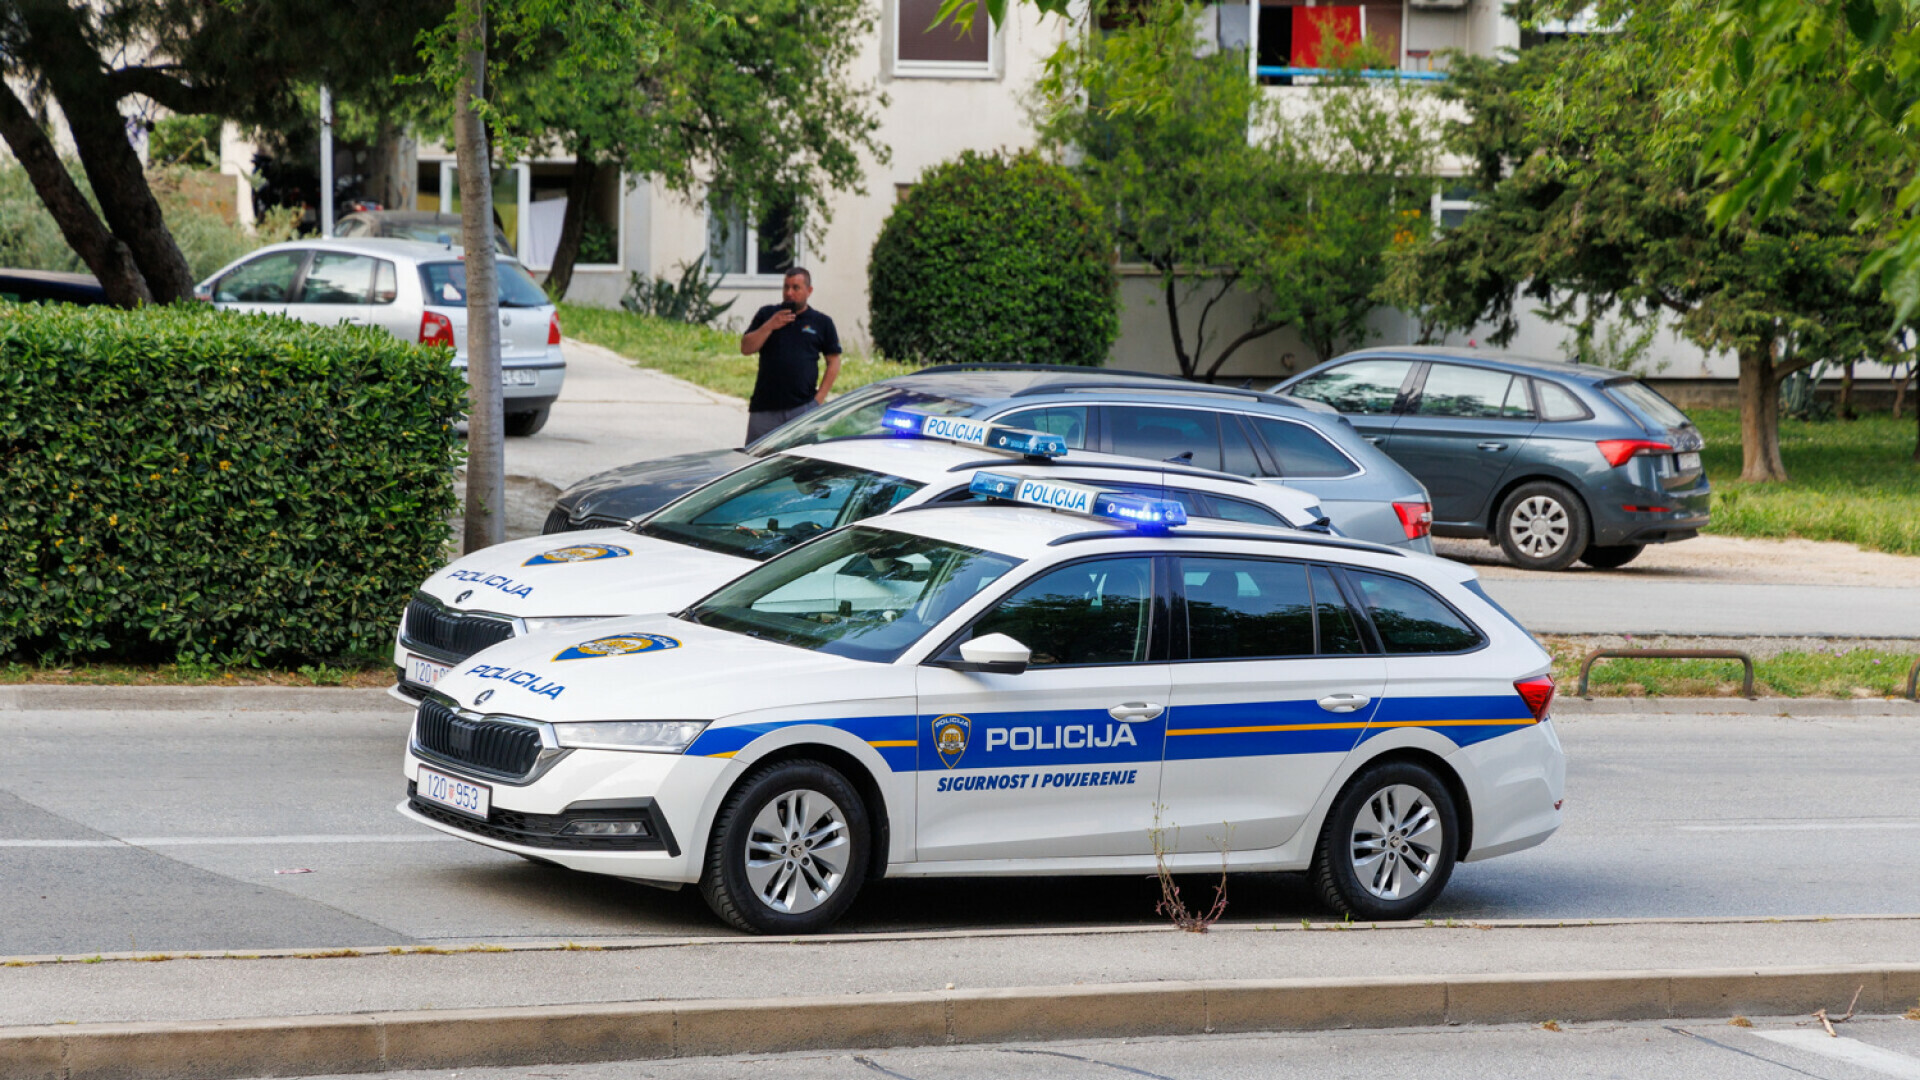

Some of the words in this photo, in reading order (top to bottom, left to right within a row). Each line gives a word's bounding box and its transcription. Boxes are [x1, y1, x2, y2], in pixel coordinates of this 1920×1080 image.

[927, 418, 984, 443] POLICIJA
[1021, 482, 1087, 510] POLICIJA
[447, 569, 534, 599] POLICIJA
[415, 661, 431, 682] 120
[465, 664, 566, 700] POLICIJA
[986, 724, 1138, 752] POLICIJA
[428, 774, 447, 800] 120
[455, 782, 478, 810] 953
[936, 774, 1030, 792] SIGURNOST
[1031, 774, 1039, 789] I
[1041, 769, 1138, 788] POVJERENJE
